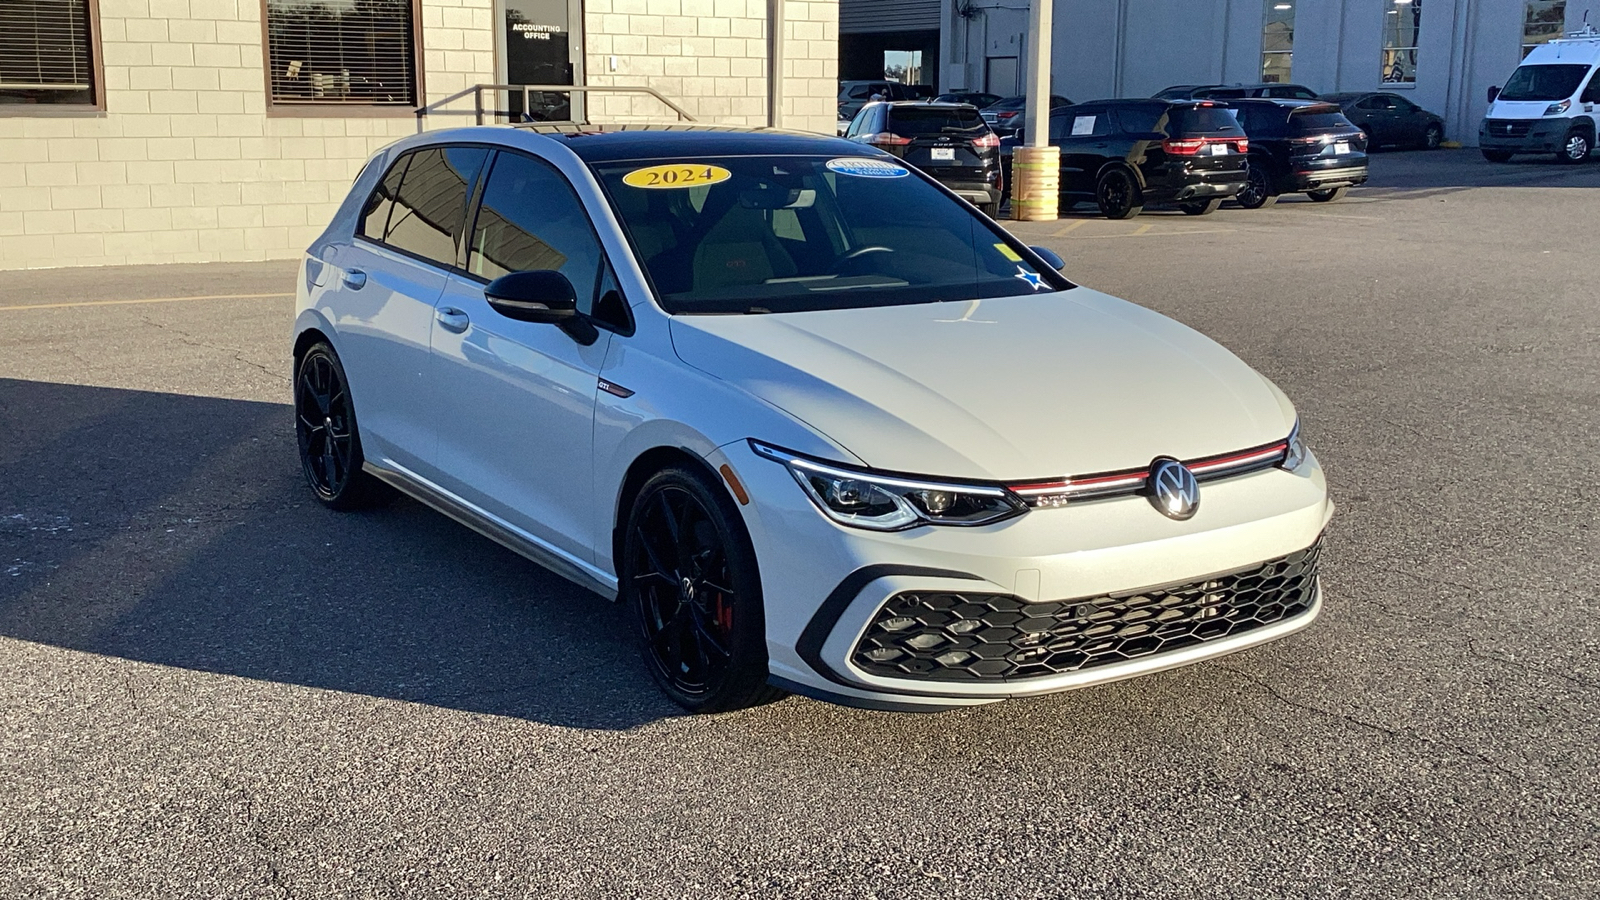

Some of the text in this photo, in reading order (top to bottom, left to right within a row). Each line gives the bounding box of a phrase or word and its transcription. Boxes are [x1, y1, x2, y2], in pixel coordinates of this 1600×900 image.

[512, 23, 561, 32] ACCOUNTING
[523, 32, 550, 40] OFFICE
[646, 167, 714, 186] 2024
[598, 381, 610, 390] GTI
